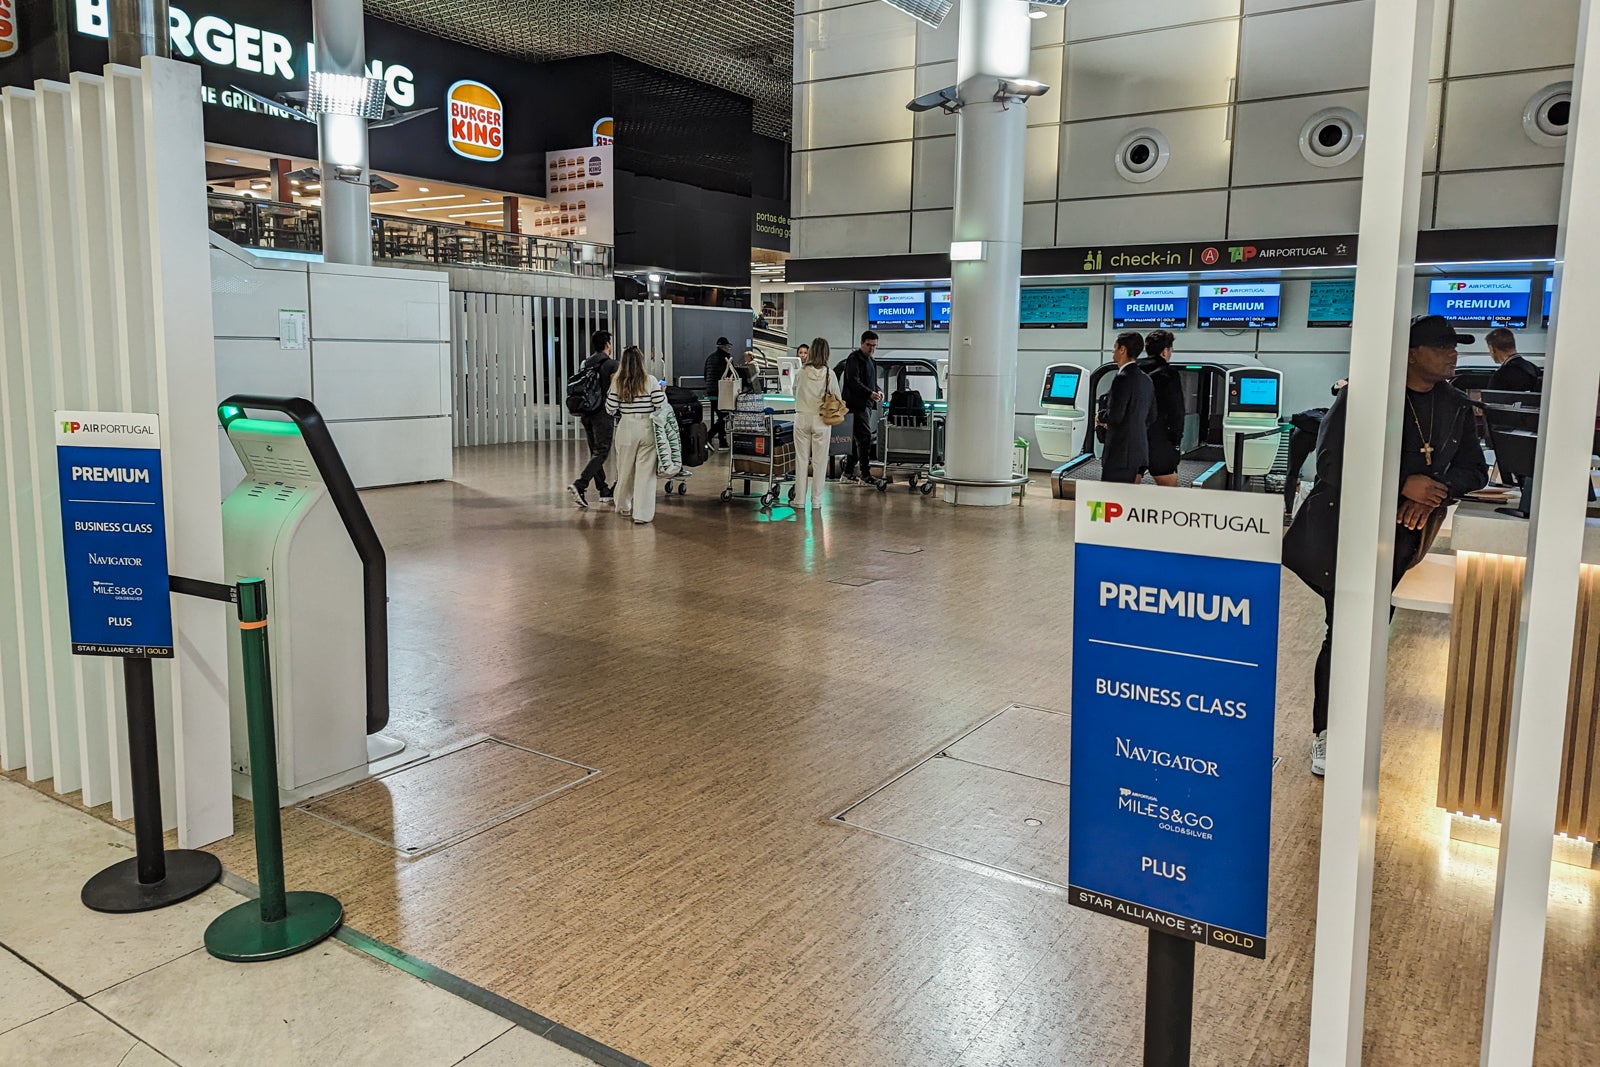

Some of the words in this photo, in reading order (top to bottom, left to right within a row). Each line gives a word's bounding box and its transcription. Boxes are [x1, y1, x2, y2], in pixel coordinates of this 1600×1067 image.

[75, 0, 296, 80] BRGER
[451, 102, 501, 127] BURGER
[452, 118, 501, 147] KING
[756, 212, 777, 222] portas
[778, 215, 787, 224] de
[756, 223, 783, 237] boarding
[1110, 251, 1181, 267] check-in
[1228, 246, 1257, 263] TAP
[878, 307, 915, 315] PREMIUM
[1126, 303, 1174, 312] PREMIUM
[1212, 302, 1264, 311] PREMIUM
[1446, 299, 1511, 309] PREMIUM
[60, 421, 80, 434] TAP
[71, 466, 150, 483] PREMIUM
[1086, 500, 1123, 523] TAP
[74, 521, 121, 532] BUSINESS
[121, 522, 153, 533] CLASS
[93, 586, 143, 595] MILES&GO
[1099, 581, 1251, 626] PREMIUM
[108, 616, 132, 627] PLUS
[97, 645, 135, 654] ALLIANCE
[1096, 678, 1181, 708] BUSINESS
[1185, 694, 1247, 720] CLASS
[1118, 796, 1214, 830] MILES&GO
[1158, 822, 1213, 840] GOLD&SILVER
[1141, 856, 1187, 882] PLUS
[1079, 892, 1113, 910] STAR
[1116, 903, 1186, 931] ALLIANCE
[1212, 930, 1254, 949] GOLD
